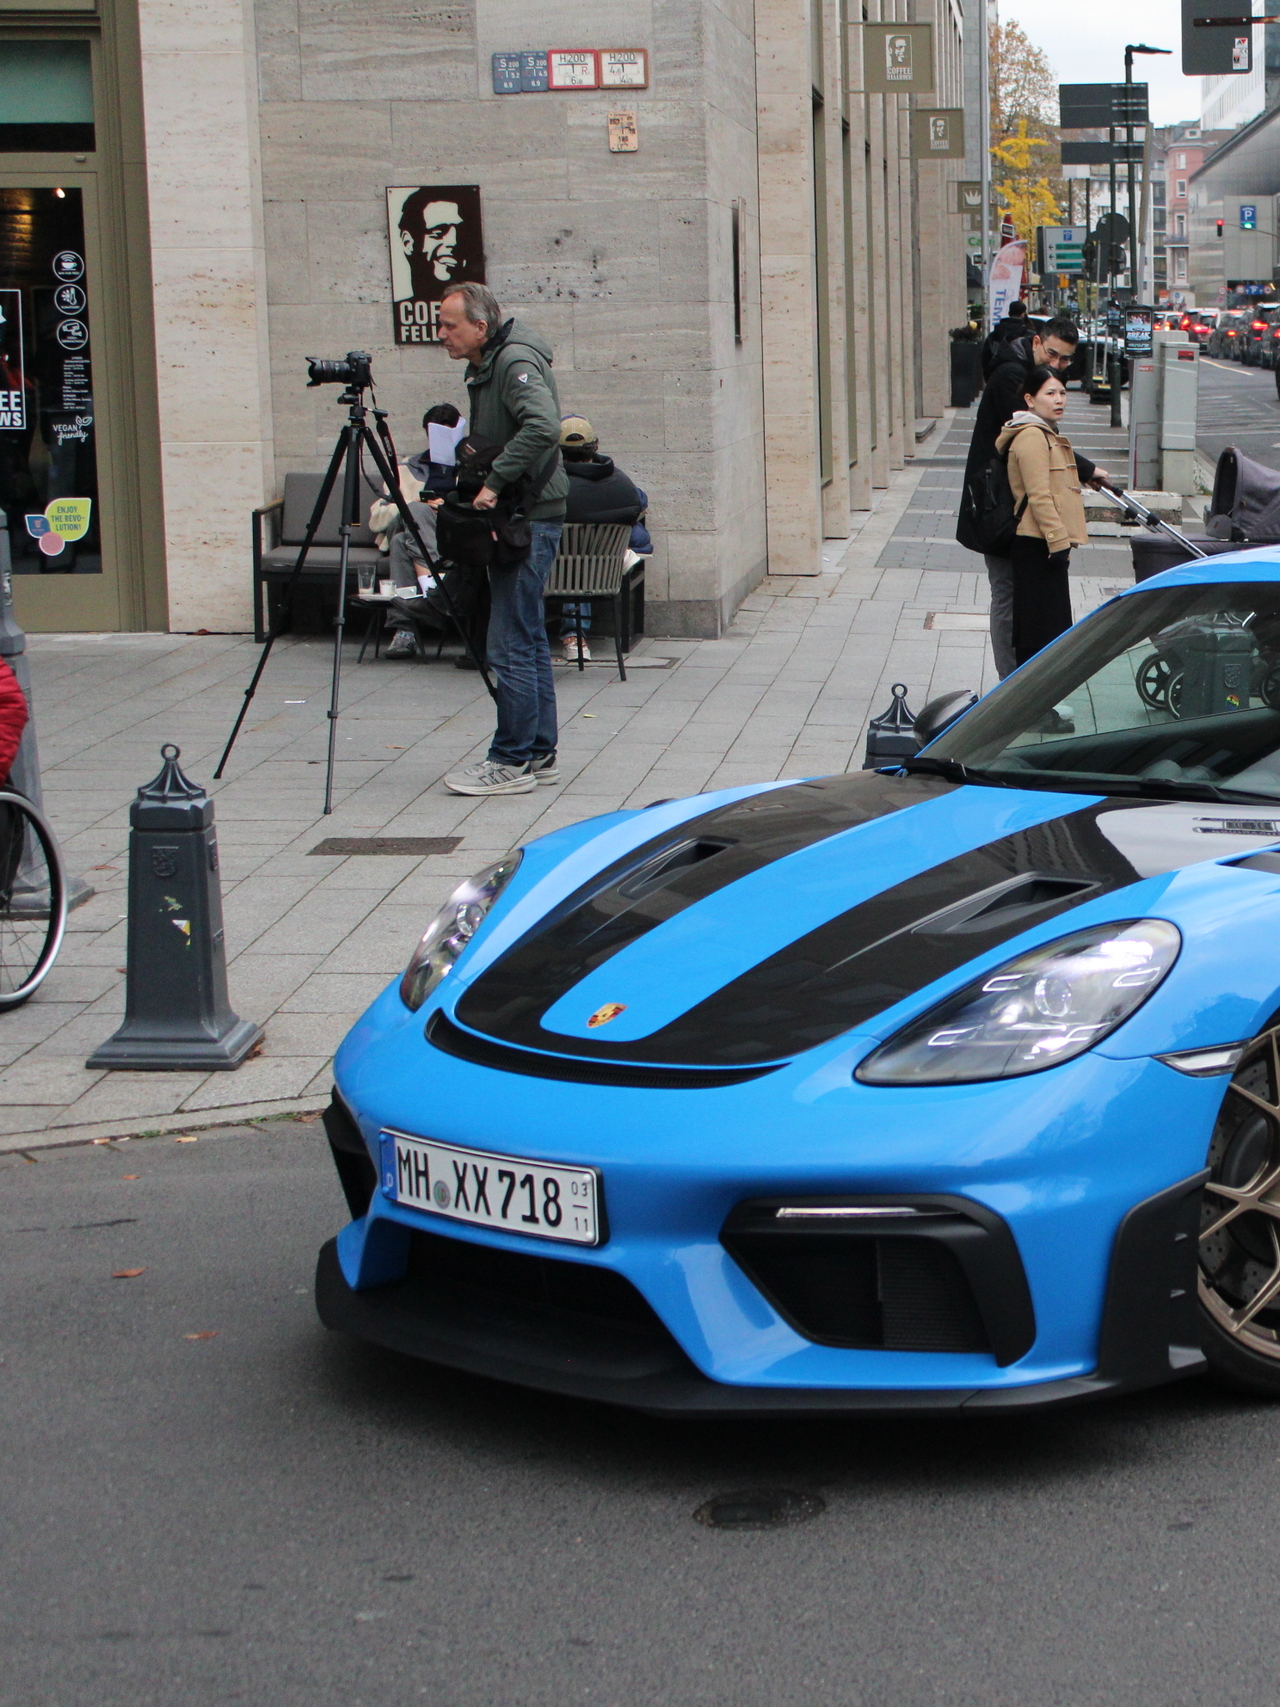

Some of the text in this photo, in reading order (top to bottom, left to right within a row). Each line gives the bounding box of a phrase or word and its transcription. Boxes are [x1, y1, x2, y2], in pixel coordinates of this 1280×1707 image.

[500, 58, 507, 68] S
[528, 57, 535, 66] S
[887, 67, 912, 75] COFFEE
[53, 424, 78, 432] VEGAN
[57, 430, 89, 446] friendly
[57, 506, 78, 514] ENJOY
[51, 515, 85, 523] THE REVO-
[56, 523, 81, 532] LUTION!
[397, 1145, 431, 1202] MH
[571, 1181, 589, 1197] 03
[574, 1216, 589, 1232] 11
